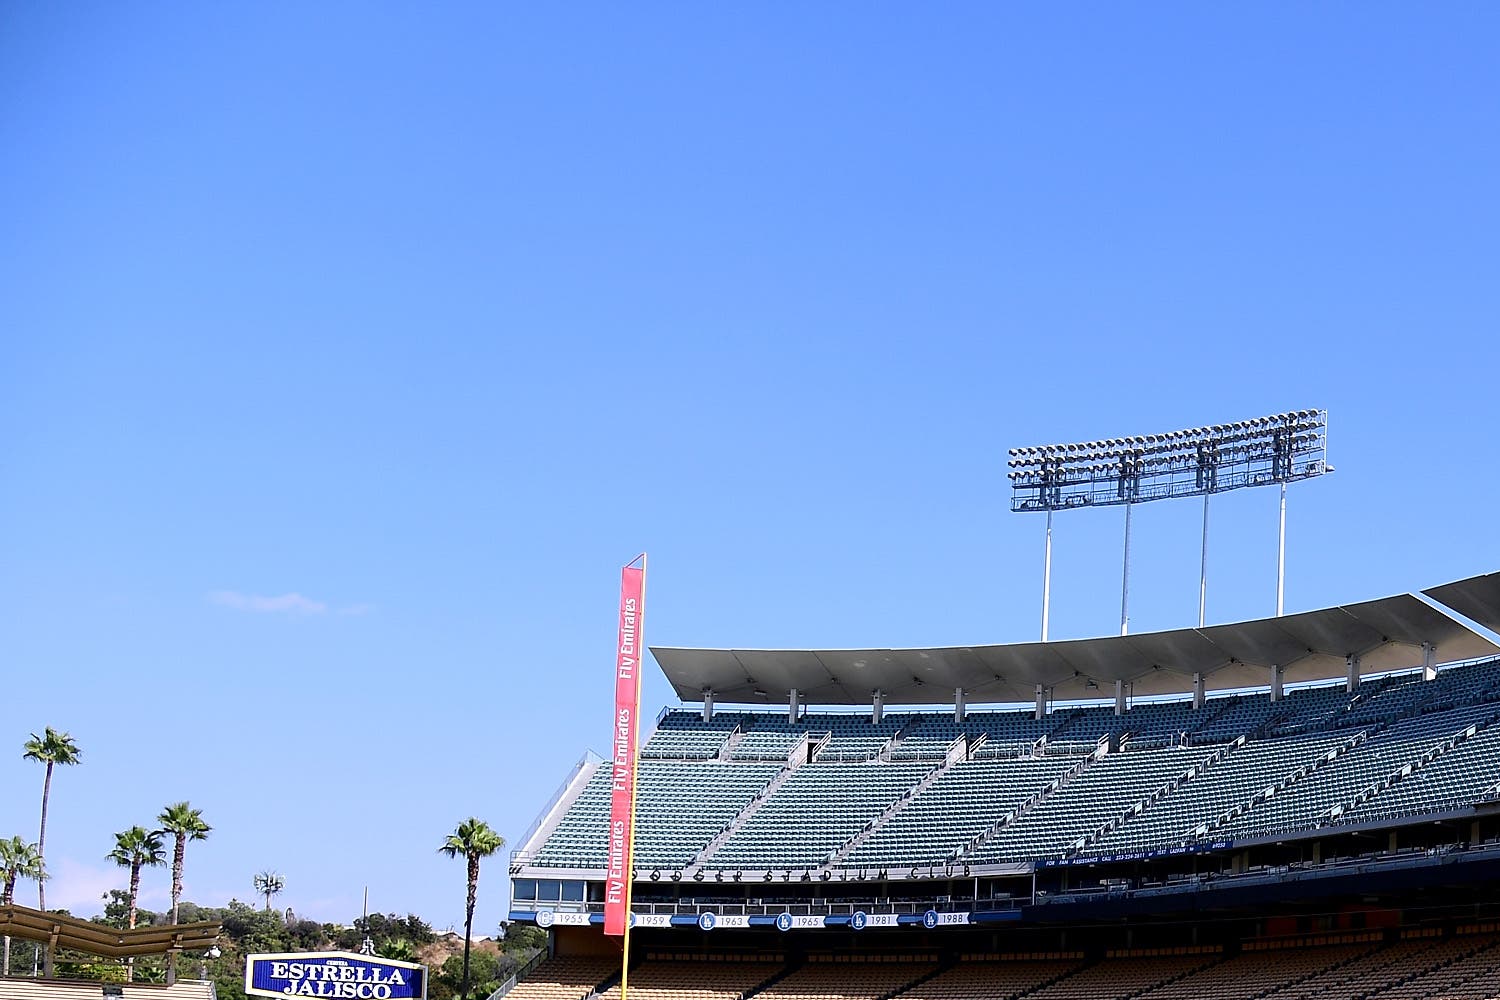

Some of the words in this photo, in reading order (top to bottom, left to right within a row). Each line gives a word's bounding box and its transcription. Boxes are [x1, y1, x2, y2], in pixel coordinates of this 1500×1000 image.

[620, 598, 636, 655] Emirates
[619, 656, 636, 679] Fly
[614, 708, 630, 766] Emirates
[613, 769, 629, 790] Fly
[610, 821, 625, 878] Emirates
[764, 869, 888, 881] STADIUM
[911, 866, 970, 879] CLUB
[608, 880, 624, 904] Fly
[559, 914, 583, 924] 1955
[641, 916, 665, 925] 1959
[720, 916, 743, 926] 1963
[797, 917, 819, 926] 1965
[871, 916, 891, 925] 1981
[942, 915, 963, 924] 1988
[270, 961, 405, 985] ESTRELLA
[283, 980, 392, 999] JALISCO
